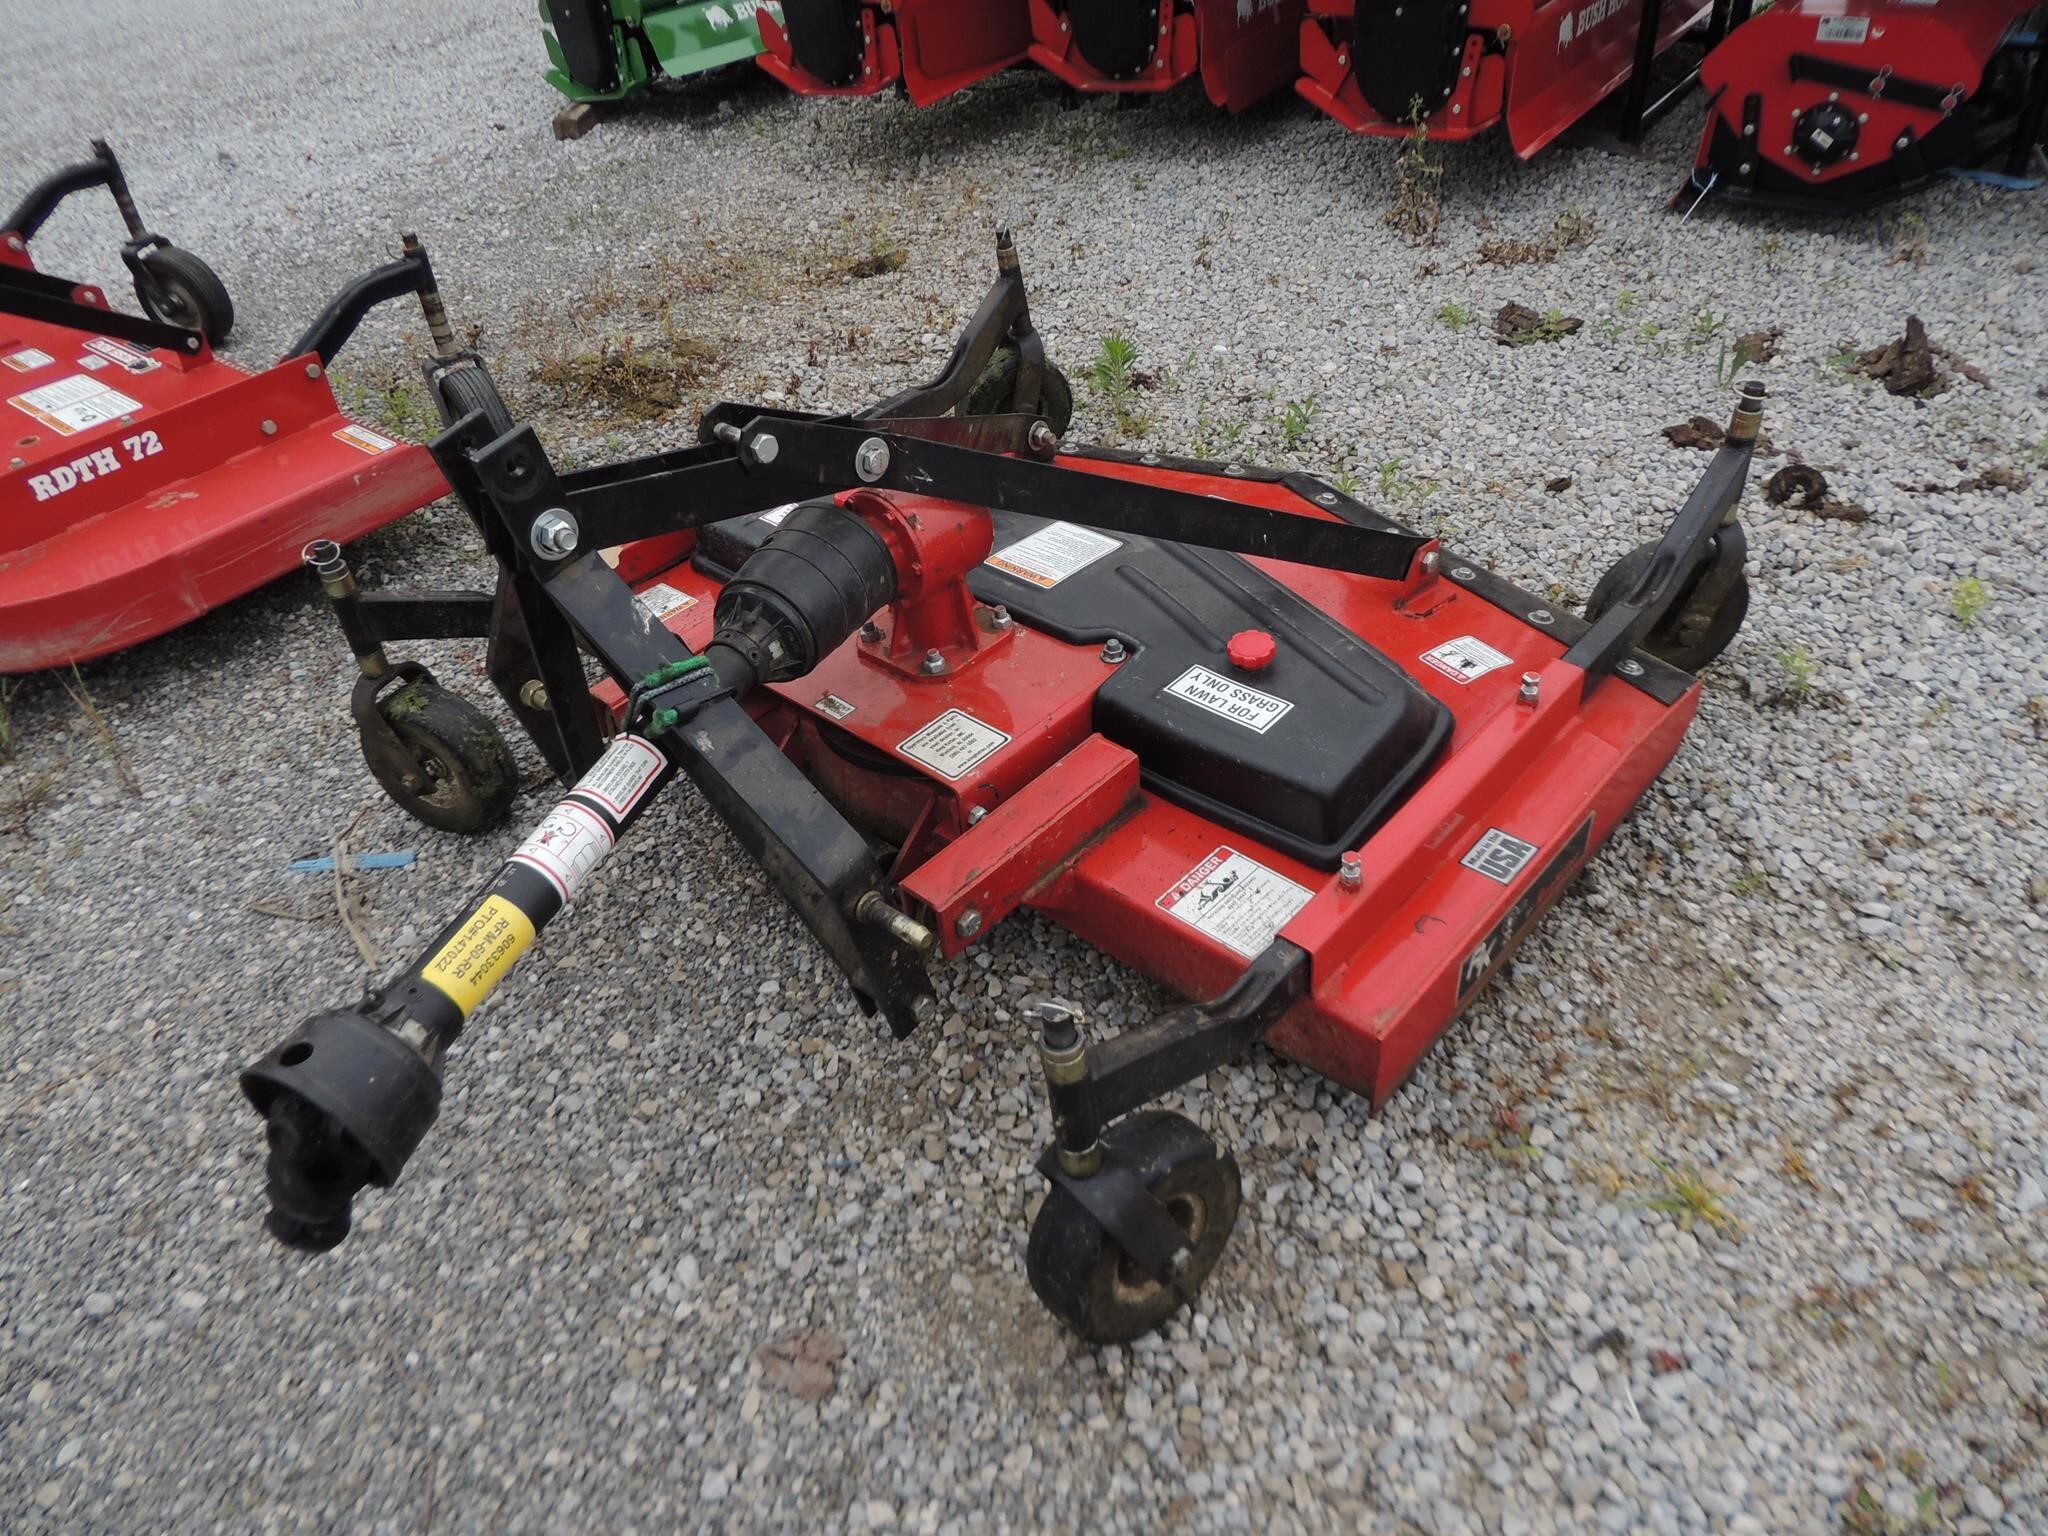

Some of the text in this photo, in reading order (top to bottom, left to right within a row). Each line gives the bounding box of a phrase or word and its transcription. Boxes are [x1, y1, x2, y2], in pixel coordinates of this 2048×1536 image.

[28, 430, 165, 503] RDTH 72
[996, 558, 1036, 579] WARNING
[1184, 685, 1261, 722] FOR LAWN
[1190, 670, 1281, 714] GRASS ONLY
[1467, 832, 1502, 865] Made in the
[1478, 838, 1532, 879] USA
[1181, 856, 1223, 891] DANGER
[451, 917, 509, 979] RFM-60-RR
[470, 933, 516, 986] 60633044
